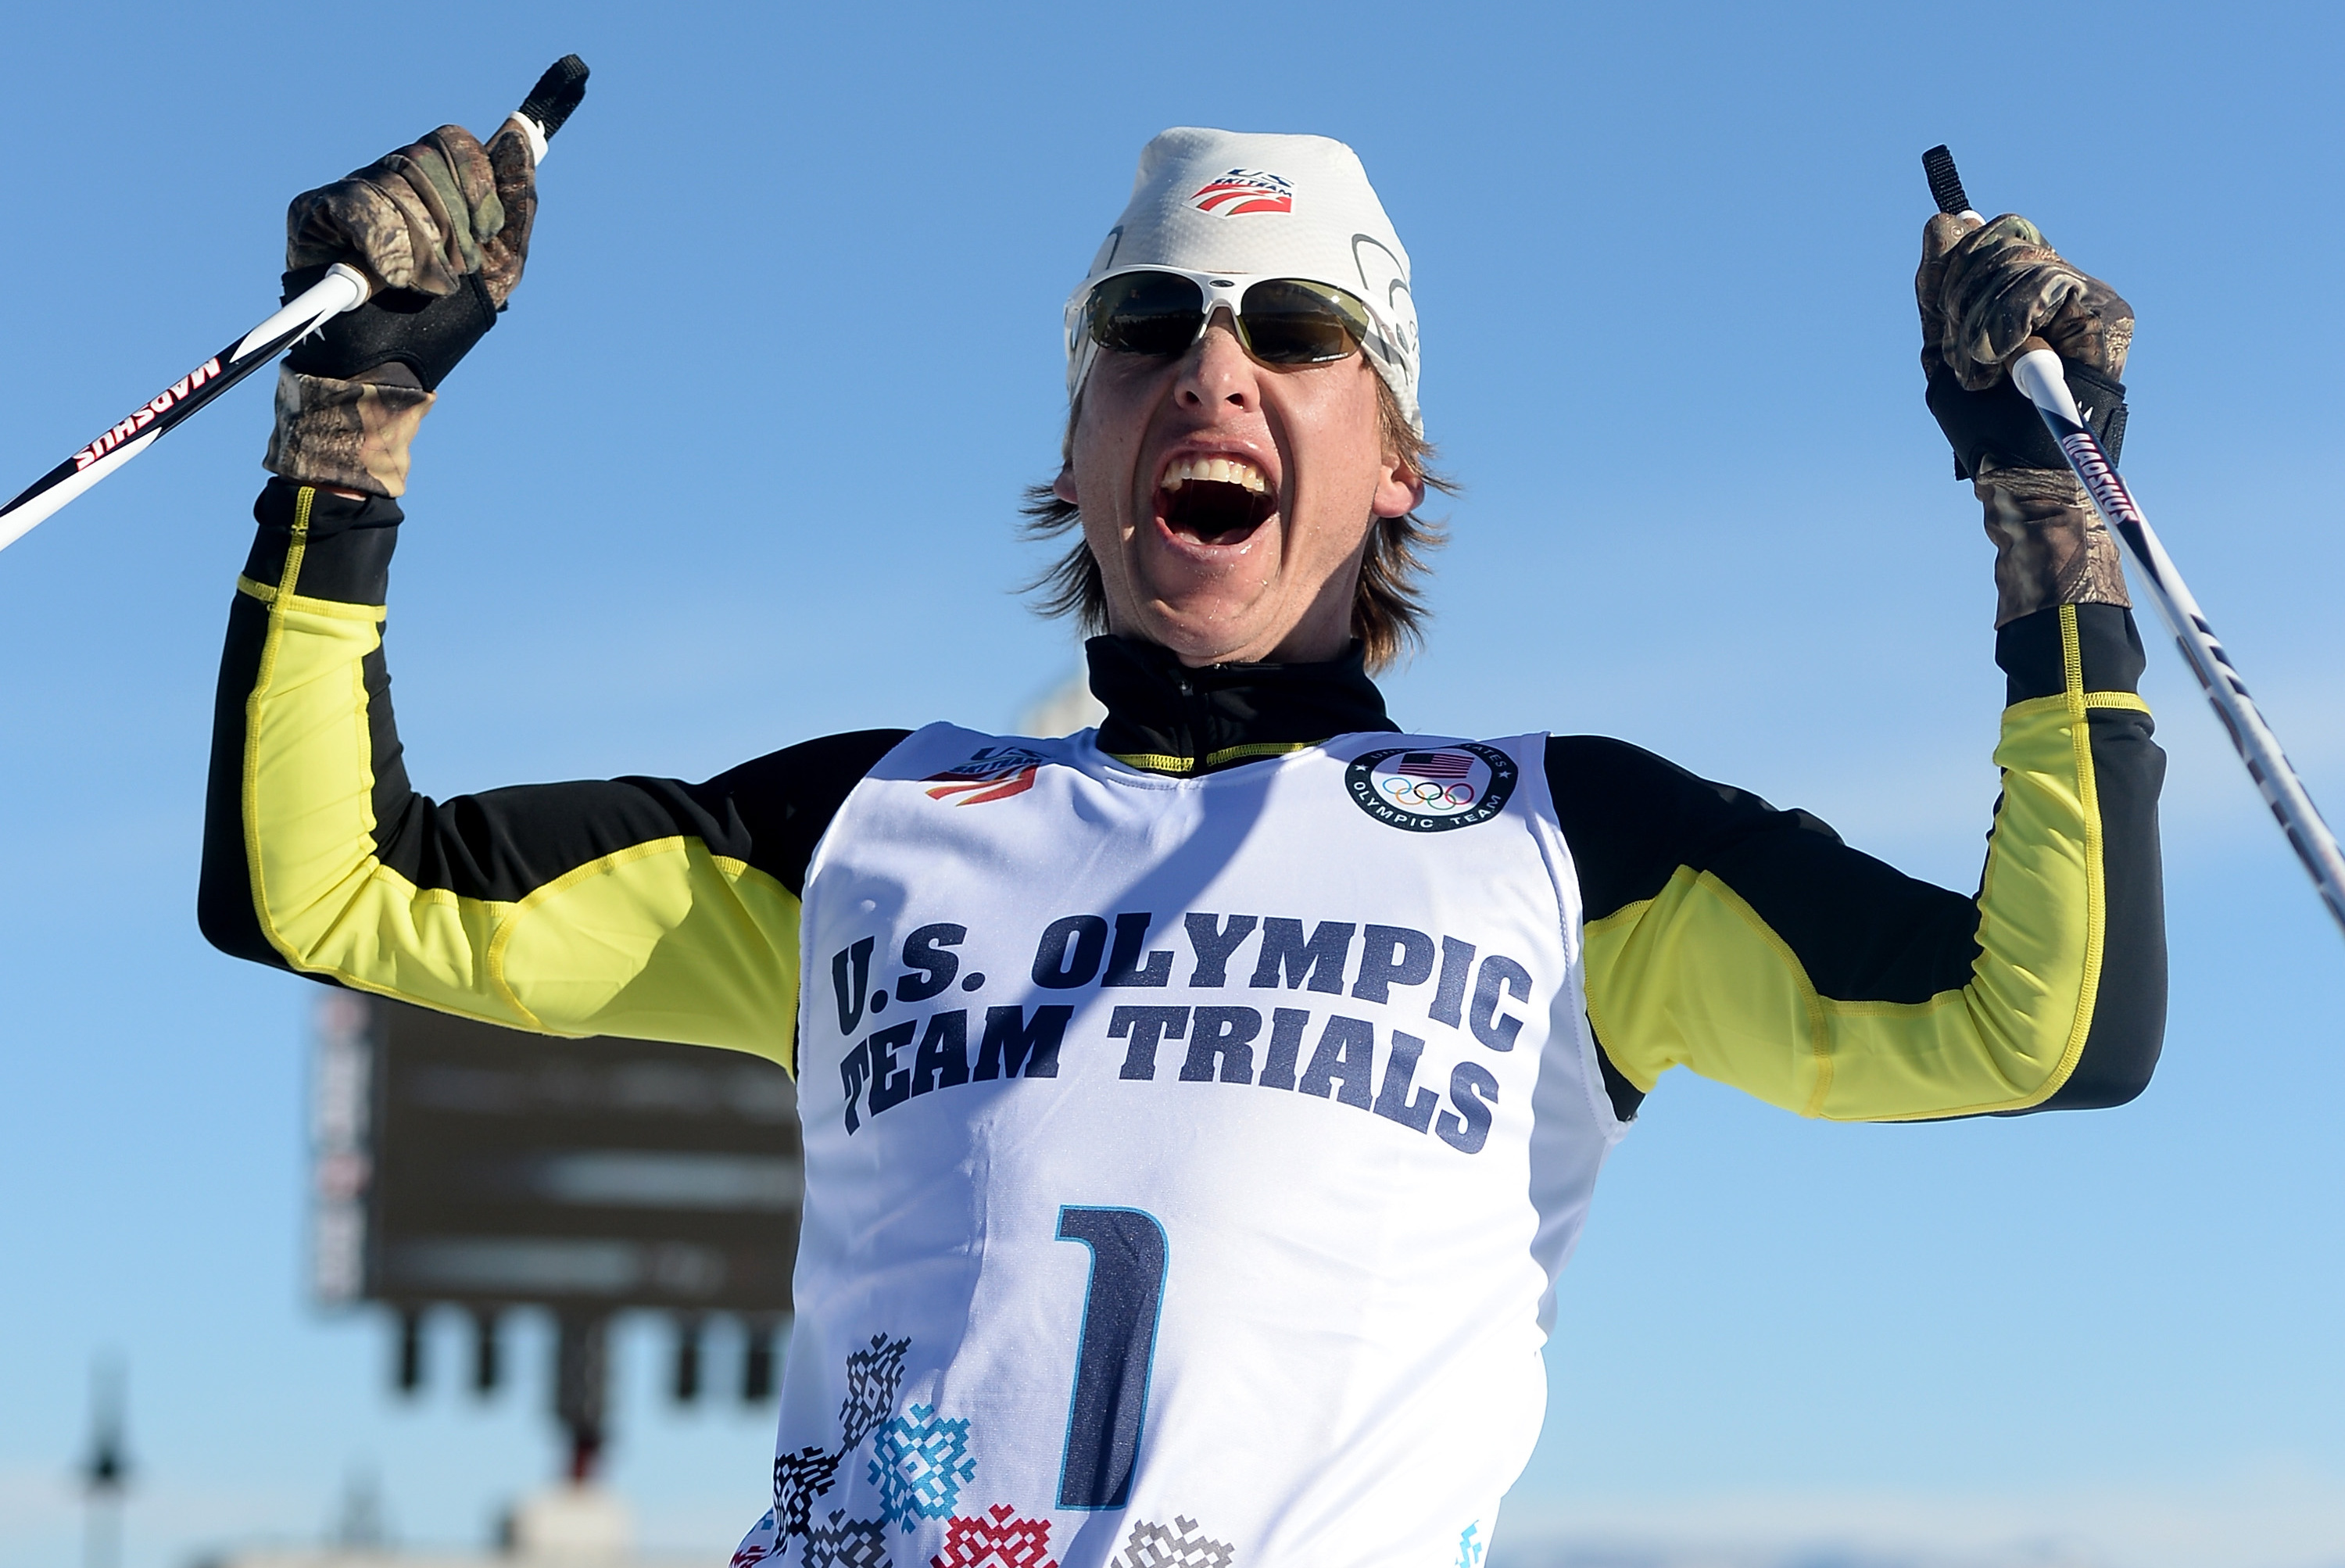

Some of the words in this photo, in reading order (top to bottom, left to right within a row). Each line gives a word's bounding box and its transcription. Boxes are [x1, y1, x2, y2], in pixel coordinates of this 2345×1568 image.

[72, 356, 222, 472] MADSHUS
[2062, 432, 2139, 525] MADSHUS
[1353, 781, 1434, 829] OLYMPIC
[1449, 794, 1502, 825] TEAM
[832, 922, 986, 1036] U.S.
[1031, 911, 1533, 1053] OLYMPIC
[840, 1004, 1075, 1137] TEAM
[1107, 1005, 1499, 1155] TRIALS
[1054, 1204, 1169, 1511] 1
